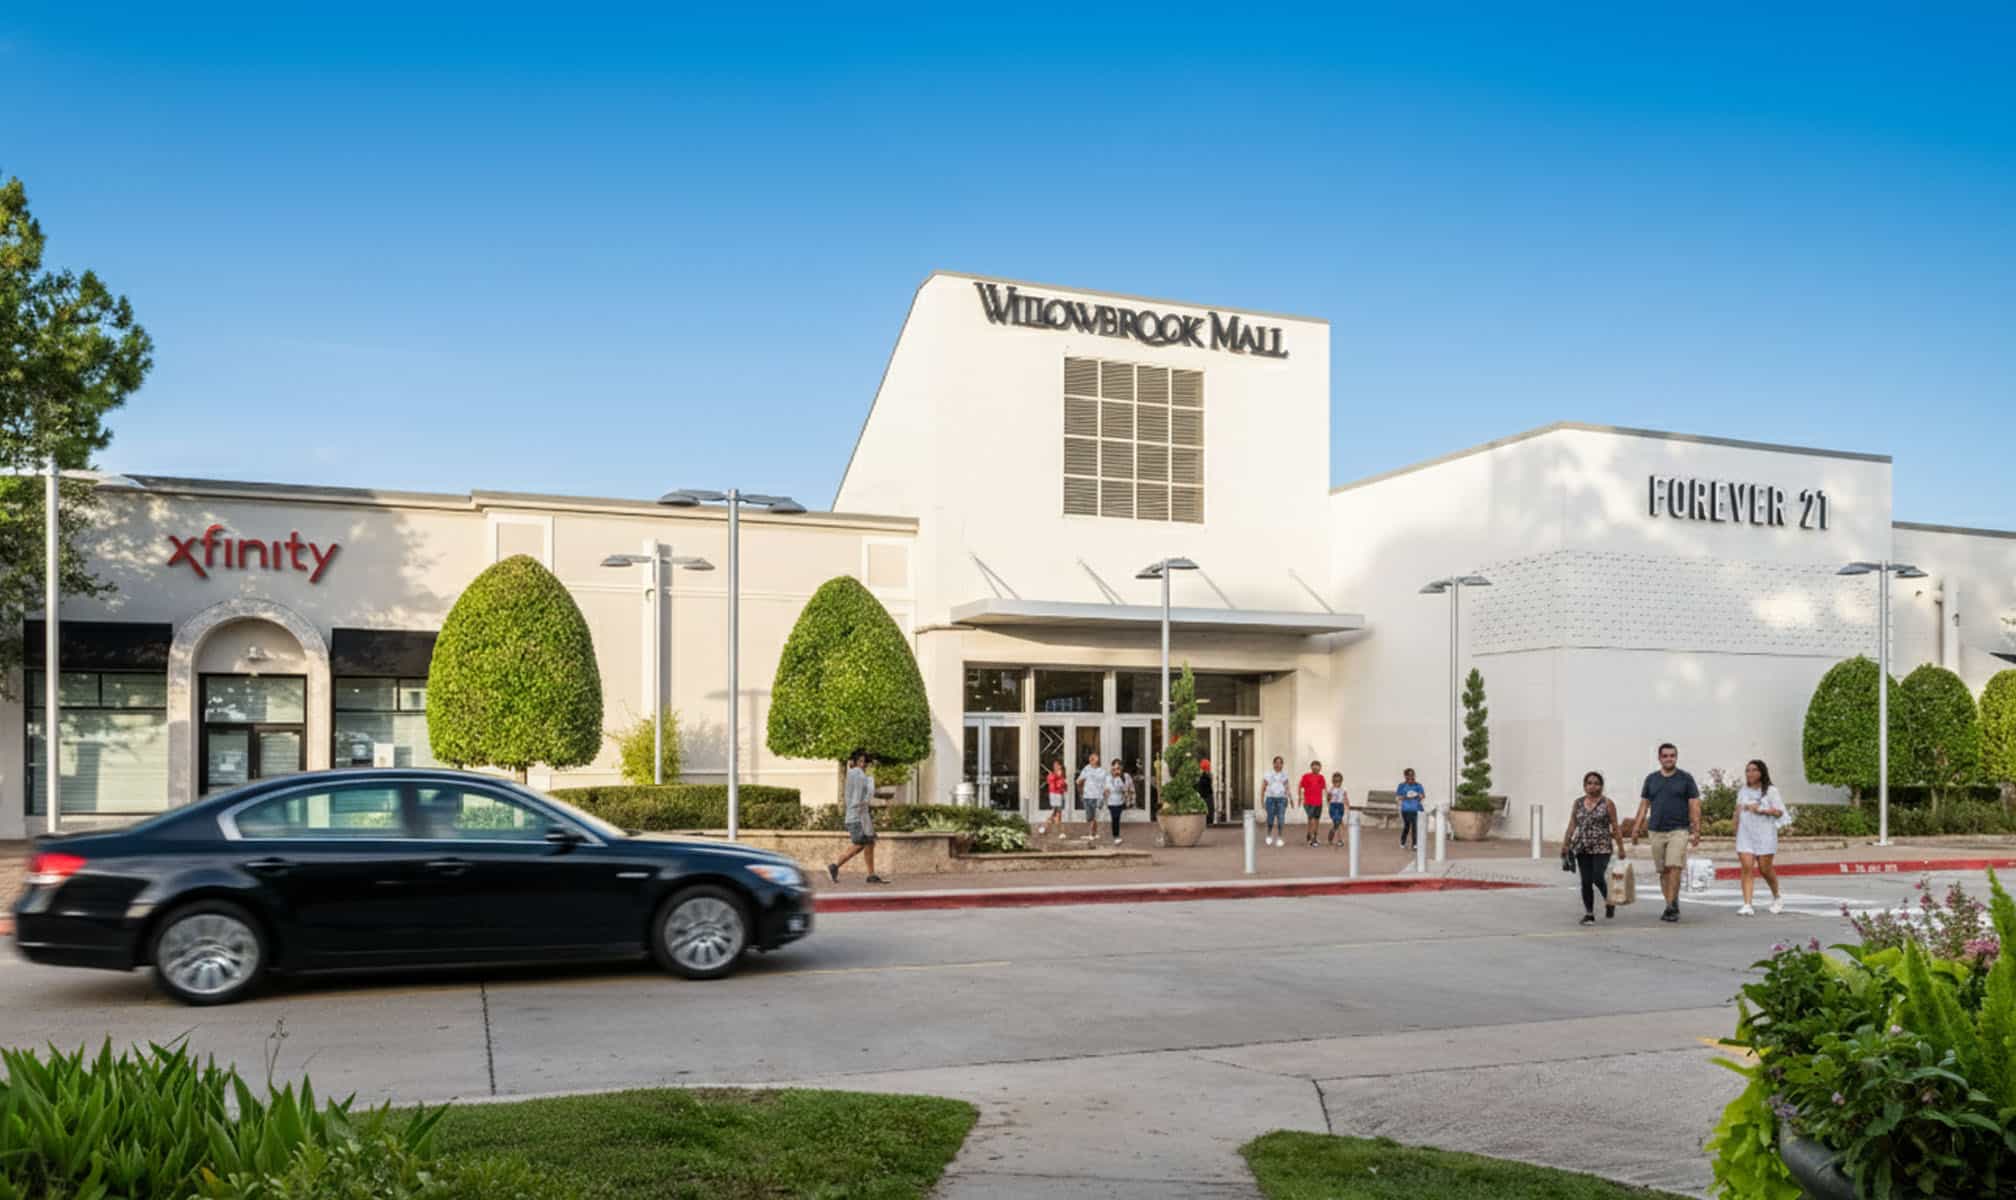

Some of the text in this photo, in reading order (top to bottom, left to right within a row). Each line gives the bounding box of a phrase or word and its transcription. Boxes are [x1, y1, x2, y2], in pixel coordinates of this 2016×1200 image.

[975, 282, 1288, 358] WILLOWBROOK MALL
[1649, 475, 1830, 530] FOREVER 21
[167, 524, 341, 584] xfinity
